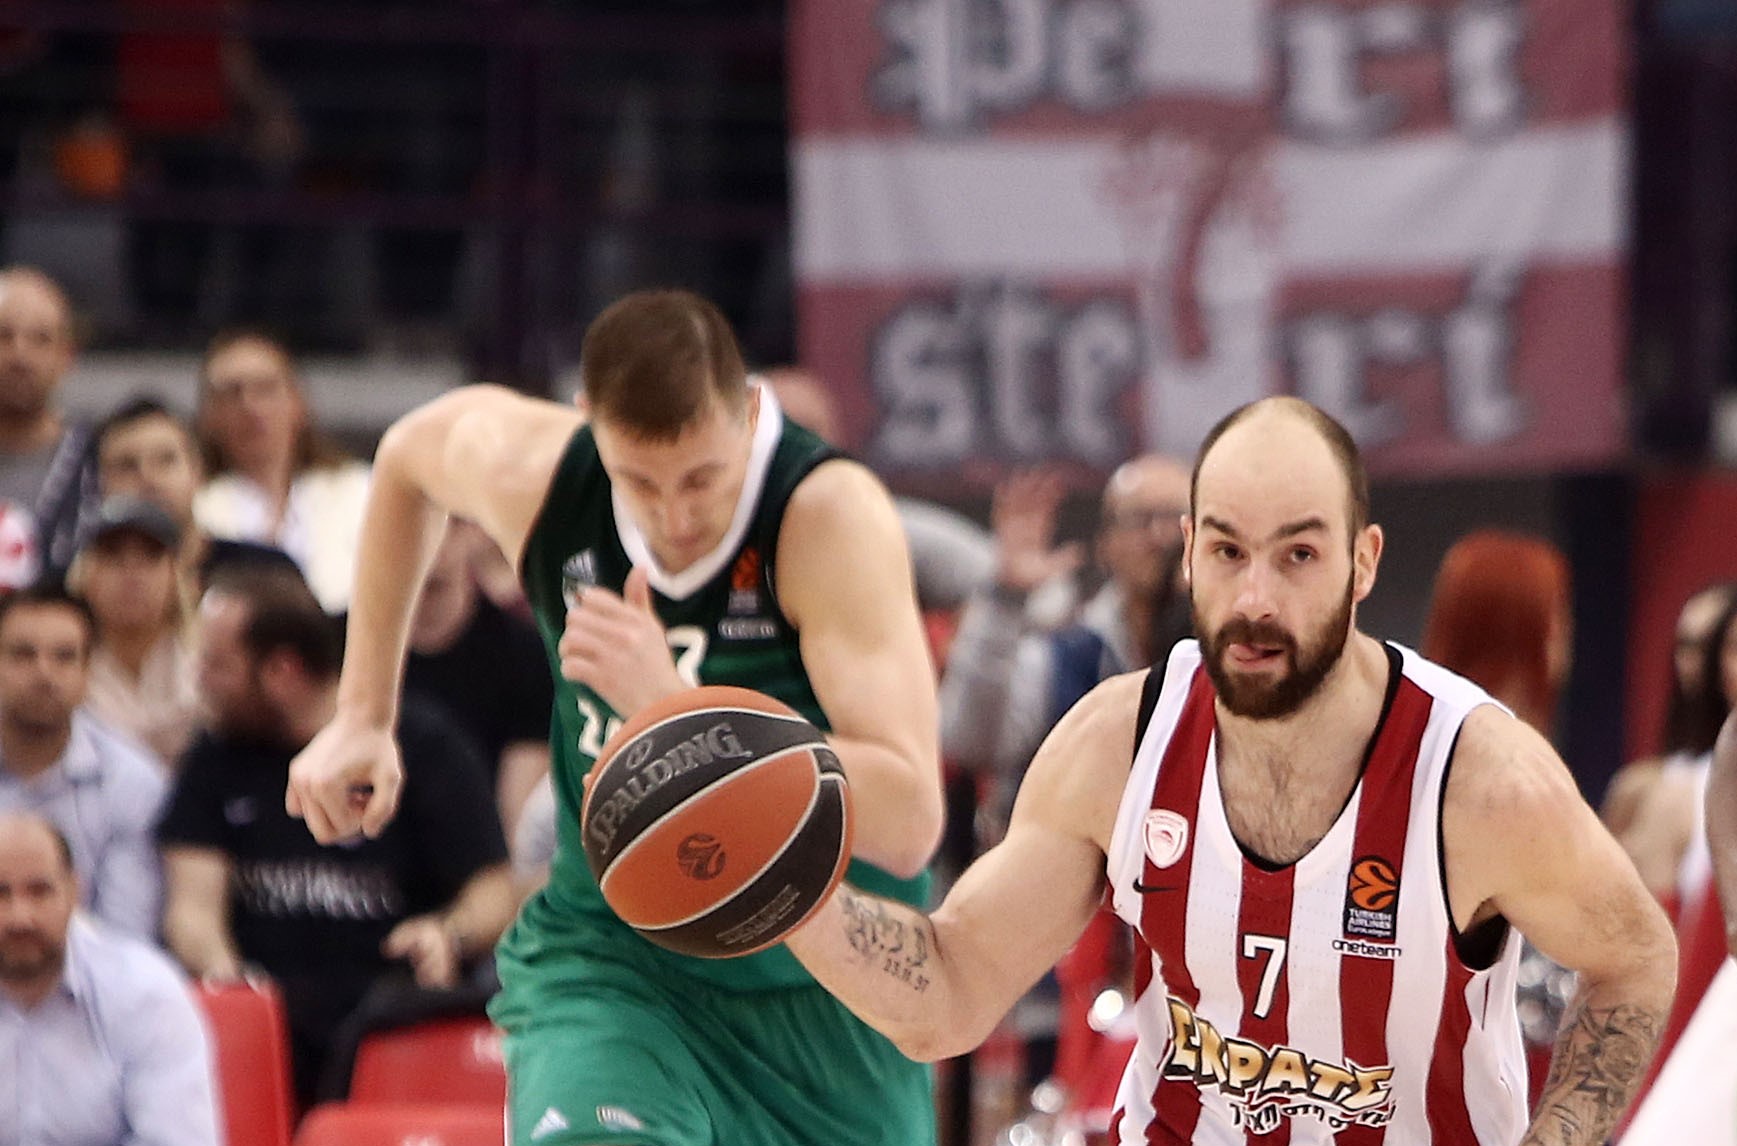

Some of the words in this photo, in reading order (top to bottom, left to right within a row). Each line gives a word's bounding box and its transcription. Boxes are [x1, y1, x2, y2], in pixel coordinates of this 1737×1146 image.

[589, 722, 753, 856] SPALDING
[1243, 934, 1287, 1019] 7
[1332, 940, 1402, 957] oneteam
